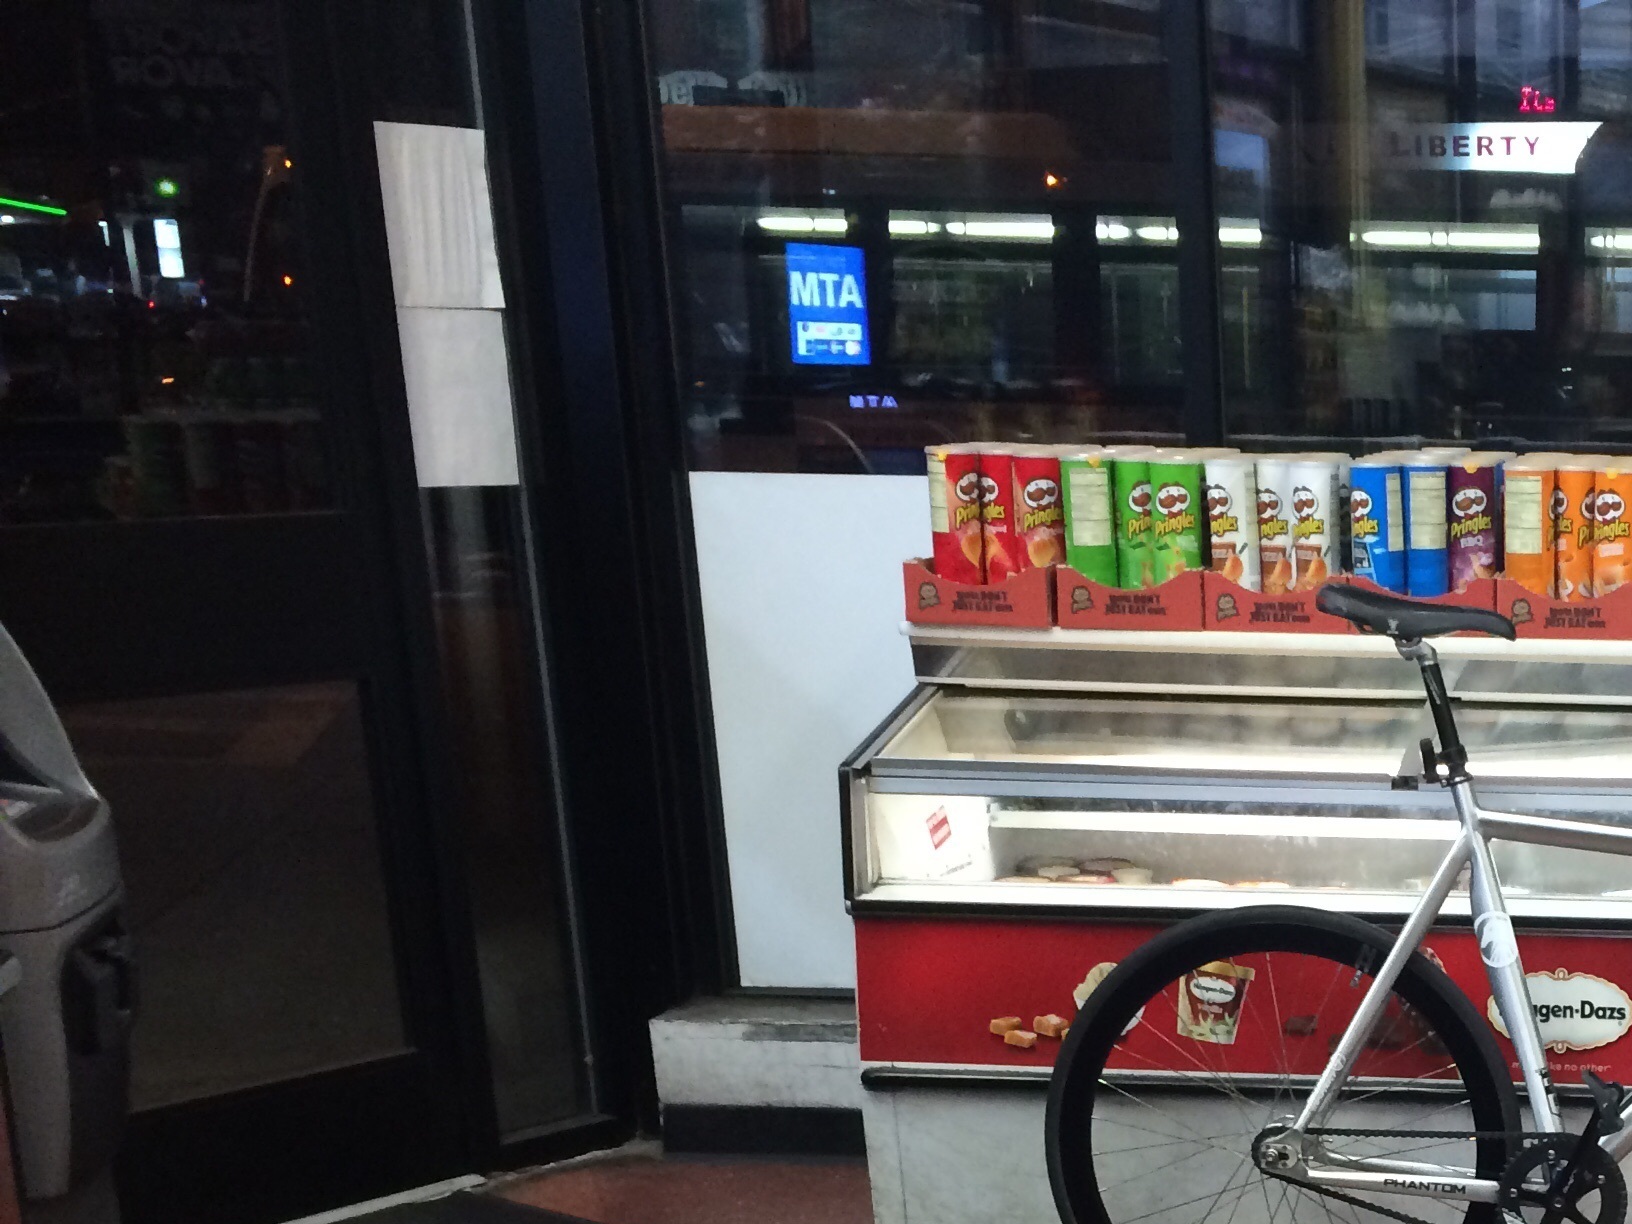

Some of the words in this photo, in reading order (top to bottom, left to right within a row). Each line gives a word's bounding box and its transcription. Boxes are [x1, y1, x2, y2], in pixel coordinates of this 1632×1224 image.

[1388, 132, 1541, 158] LIBERTY
[790, 271, 864, 308] MTA
[849, 395, 899, 408] MTA
[1155, 511, 1195, 537] Pringles
[1451, 513, 1492, 543] Pringles
[1383, 1178, 1467, 1195] PHANTOM
